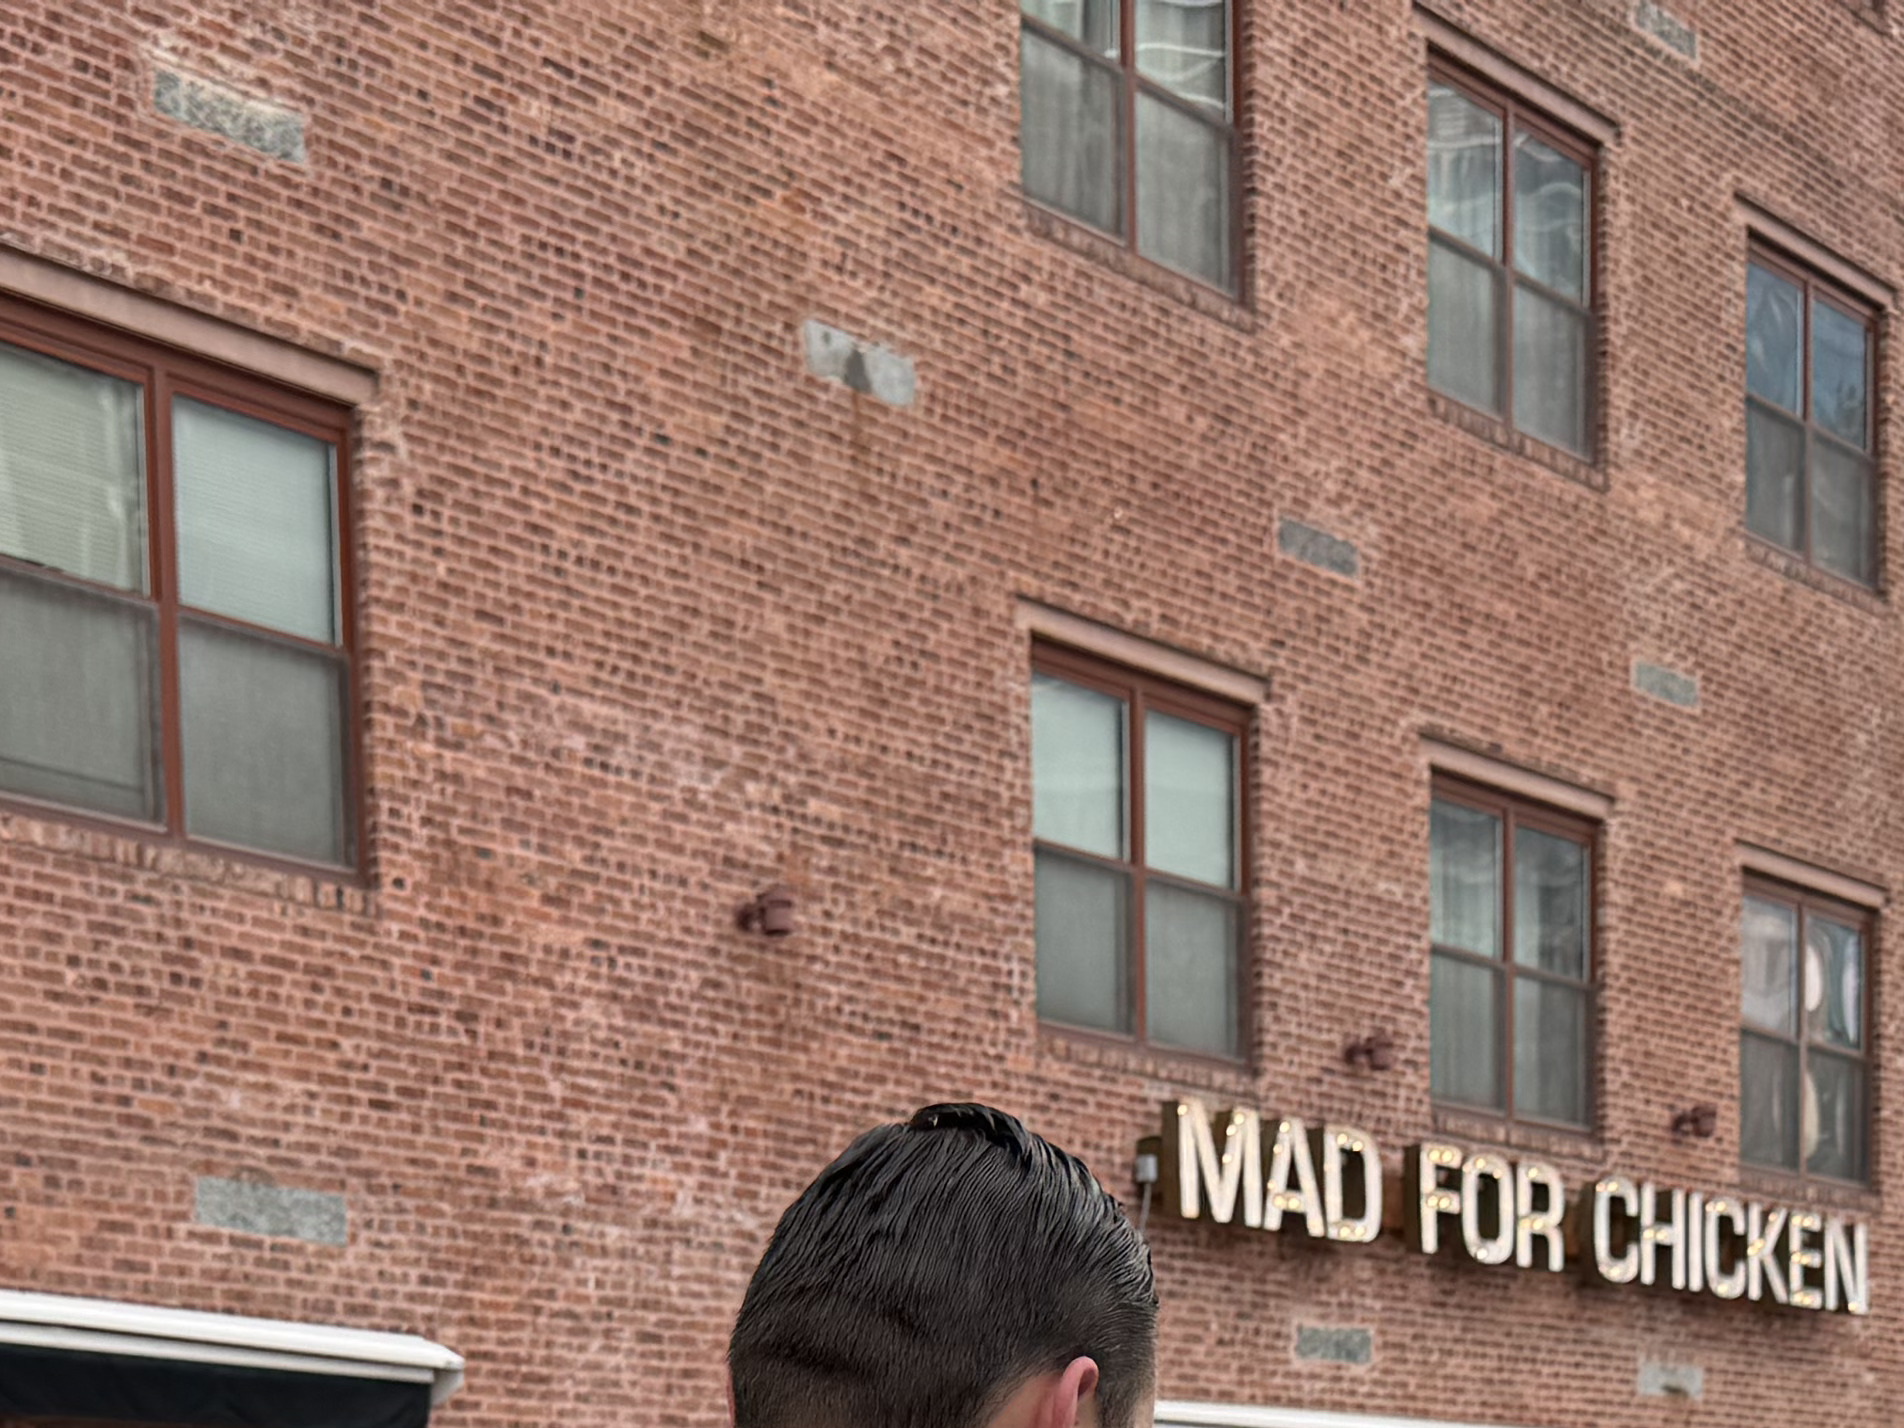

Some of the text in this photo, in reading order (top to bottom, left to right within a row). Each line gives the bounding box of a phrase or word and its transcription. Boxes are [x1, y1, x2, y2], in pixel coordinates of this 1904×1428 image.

[1177, 1099, 1869, 1315] MAD FOR CHICKEN
